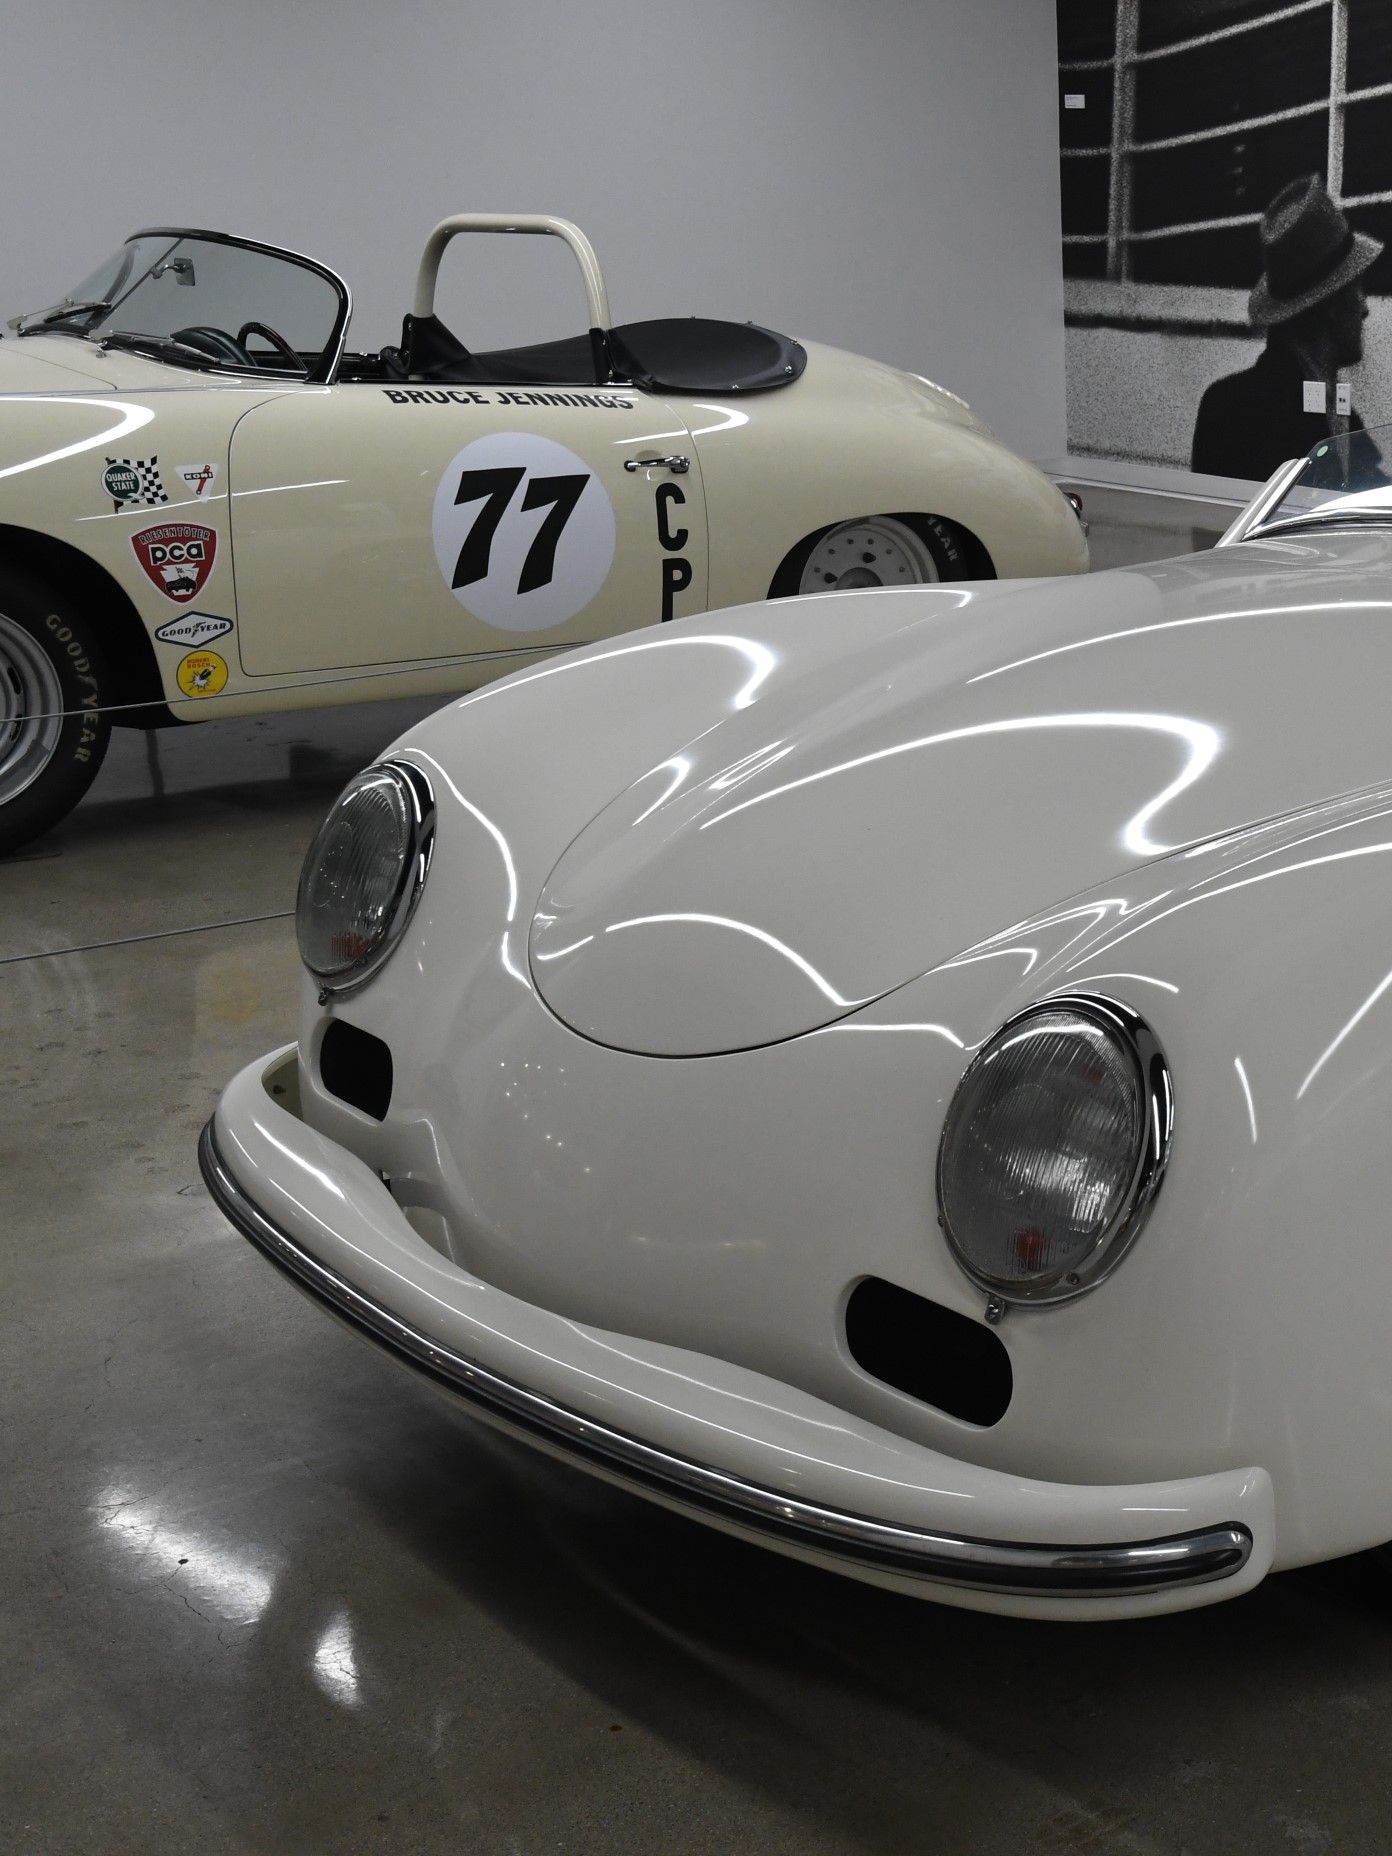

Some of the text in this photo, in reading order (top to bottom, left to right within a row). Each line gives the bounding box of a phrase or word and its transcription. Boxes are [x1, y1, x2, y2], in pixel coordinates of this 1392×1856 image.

[382, 389, 634, 409] BRUCE JENNINGS
[106, 472, 136, 482] QUAKER
[184, 472, 213, 480] KONI
[112, 481, 136, 491] STATE
[452, 467, 590, 594] 77
